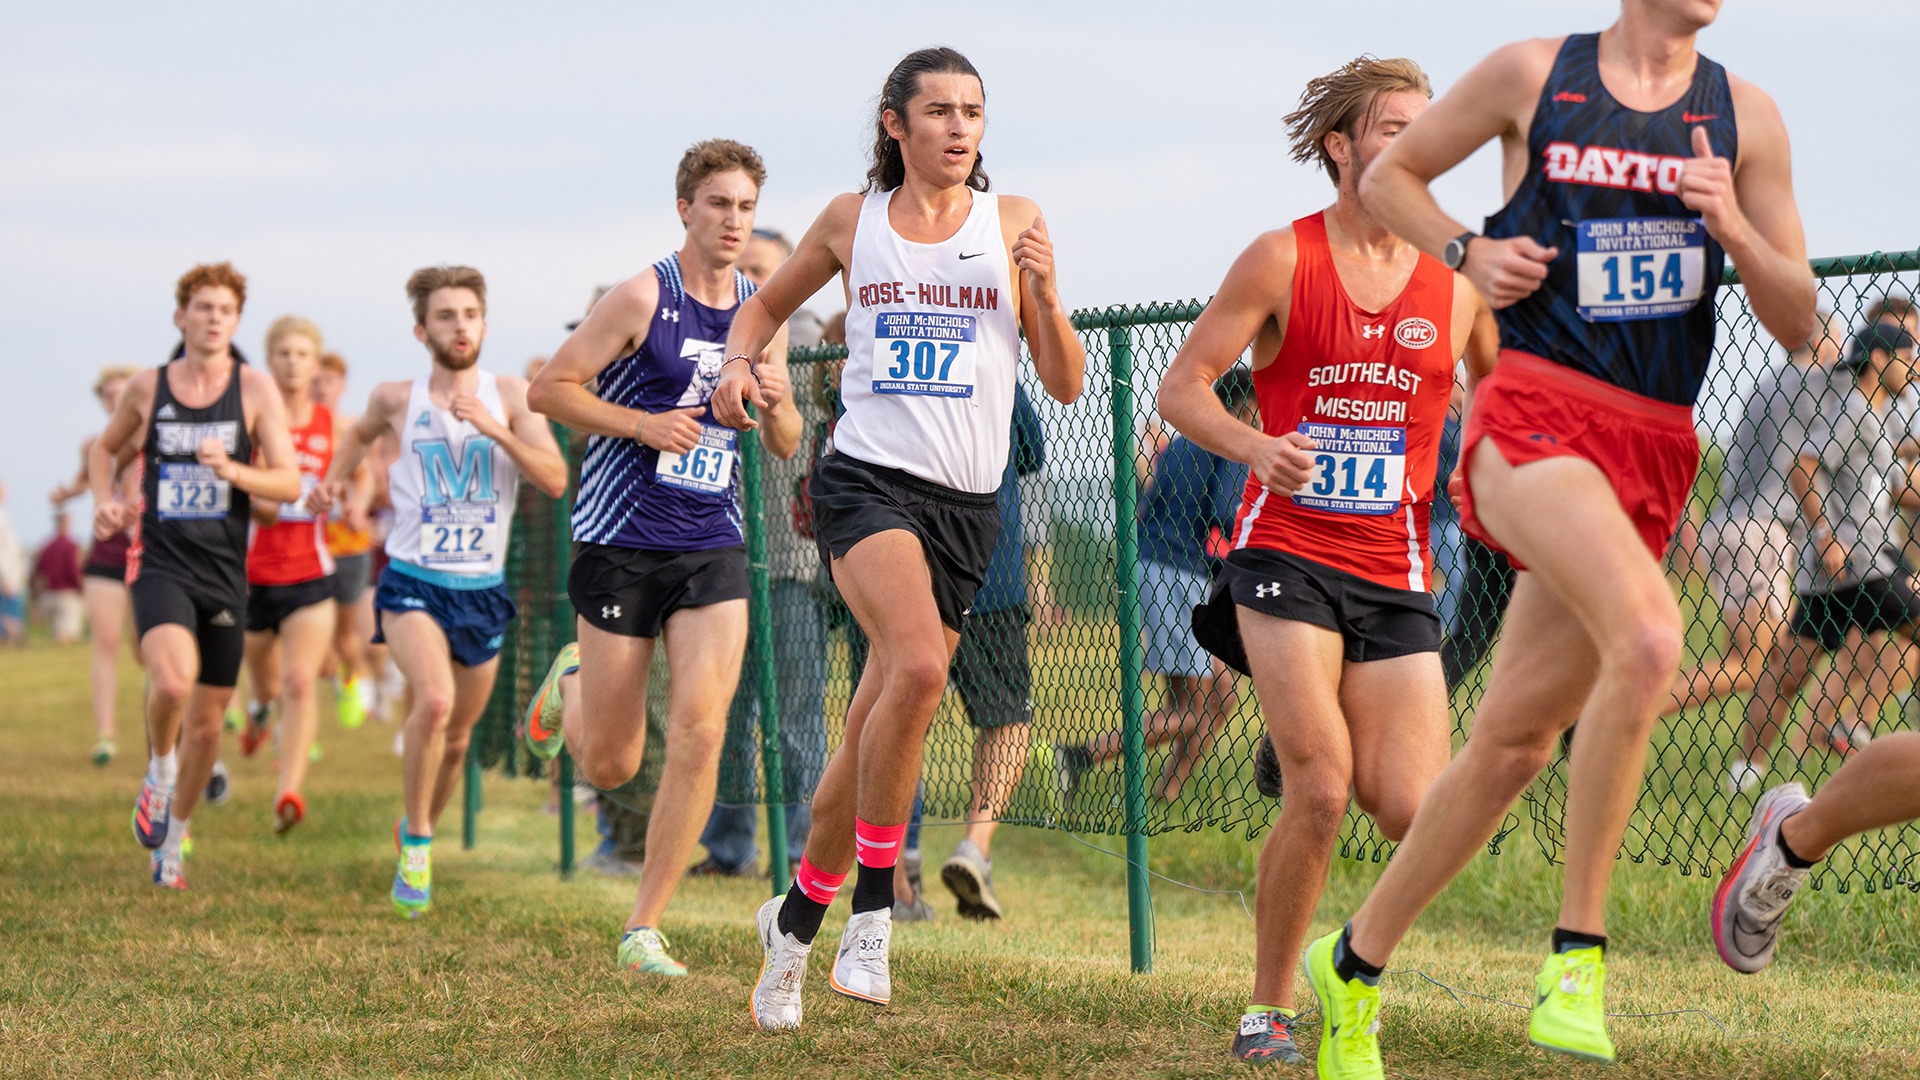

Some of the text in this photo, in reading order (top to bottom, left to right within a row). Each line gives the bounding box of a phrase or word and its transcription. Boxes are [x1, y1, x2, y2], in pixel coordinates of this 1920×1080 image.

[1543, 142, 1685, 195] DAYTO
[1587, 220, 1697, 237] JOHN McNICHOLS
[1596, 234, 1686, 251] INVITATIONAL
[1602, 253, 1684, 301] 154
[859, 282, 998, 310] ROSE-HULMAN
[883, 314, 970, 328] JOHN McNICHOLS
[1590, 307, 1623, 317] INDIANA
[1625, 305, 1649, 316] STATE
[889, 326, 963, 339] INVITATIONAL
[1403, 327, 1428, 340] OVC
[888, 340, 960, 381] 307
[880, 382, 905, 390] INDIANA
[907, 383, 928, 391] STATE
[929, 385, 967, 394] UNIVERSITY
[1308, 362, 1422, 396] SOUTHEAST
[1314, 395, 1406, 422] MISSOURI
[697, 435, 728, 450] ATIONAL
[1305, 425, 1400, 442] JOHN McNICHOLS
[412, 436, 498, 507] M
[671, 447, 724, 483] 363
[1312, 454, 1387, 498] 314
[170, 482, 217, 511] 323
[1300, 497, 1329, 507] INDIANA
[1330, 501, 1354, 509] STATE
[1355, 503, 1394, 511] UNIVERSITY
[434, 527, 484, 553] 212
